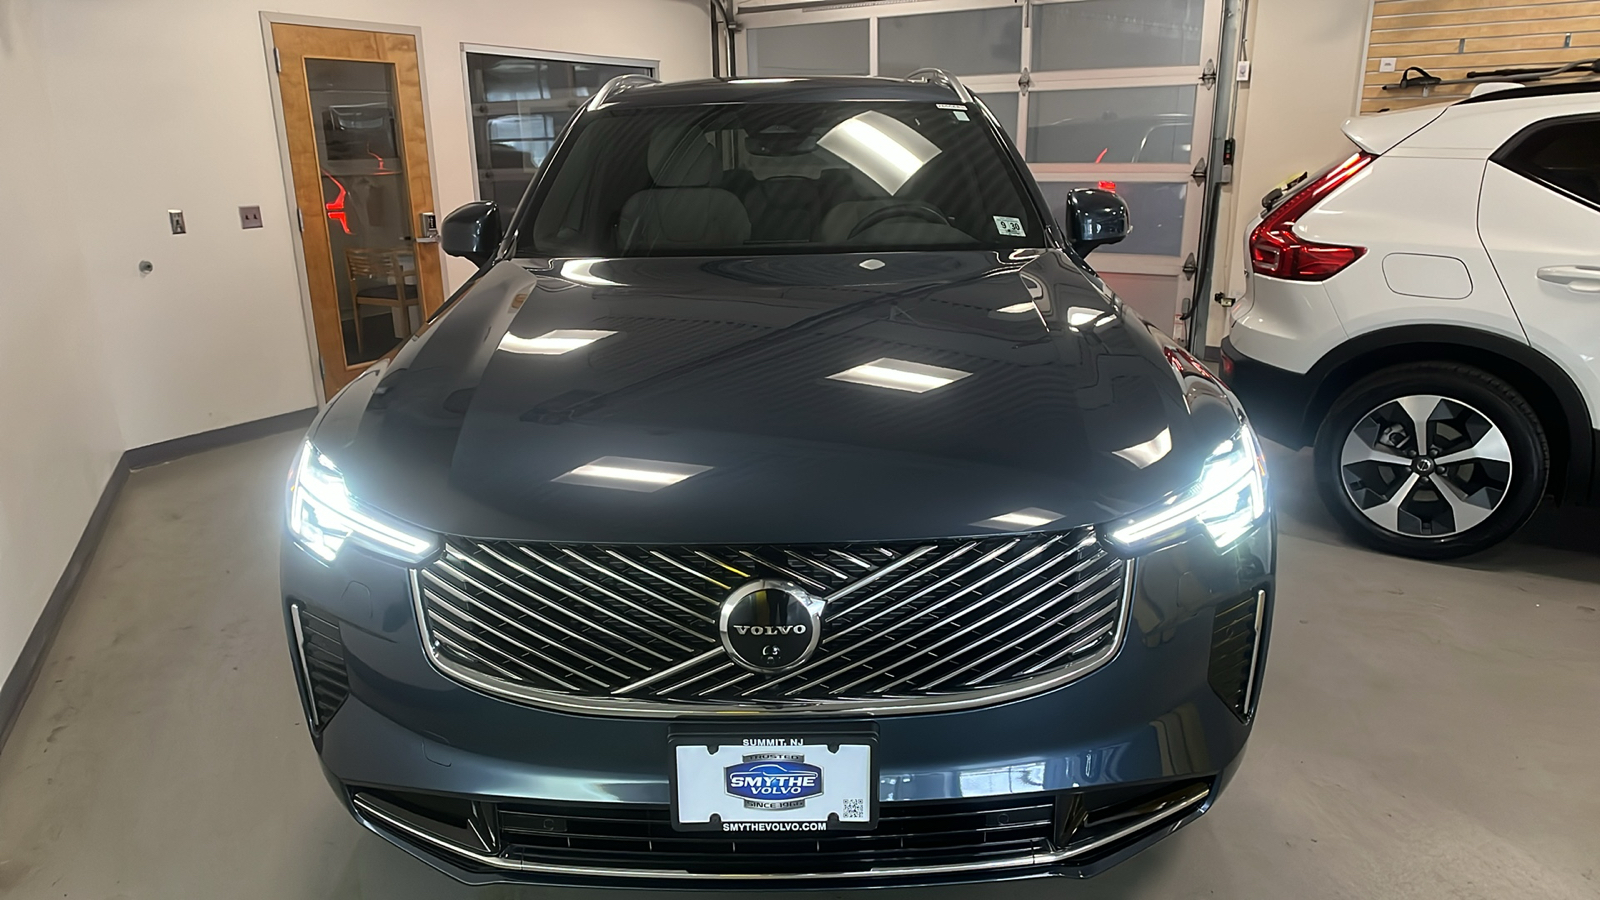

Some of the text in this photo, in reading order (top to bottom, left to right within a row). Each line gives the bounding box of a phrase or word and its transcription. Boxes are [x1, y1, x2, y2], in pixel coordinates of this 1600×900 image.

[1000, 221, 1020, 231] 9 30
[733, 624, 807, 635] VOLVO
[790, 738, 804, 746] NJ
[730, 776, 816, 787] SMYTHE
[751, 786, 801, 794] VOLVO
[723, 822, 827, 831] SMYTHEVOLVO.COM
